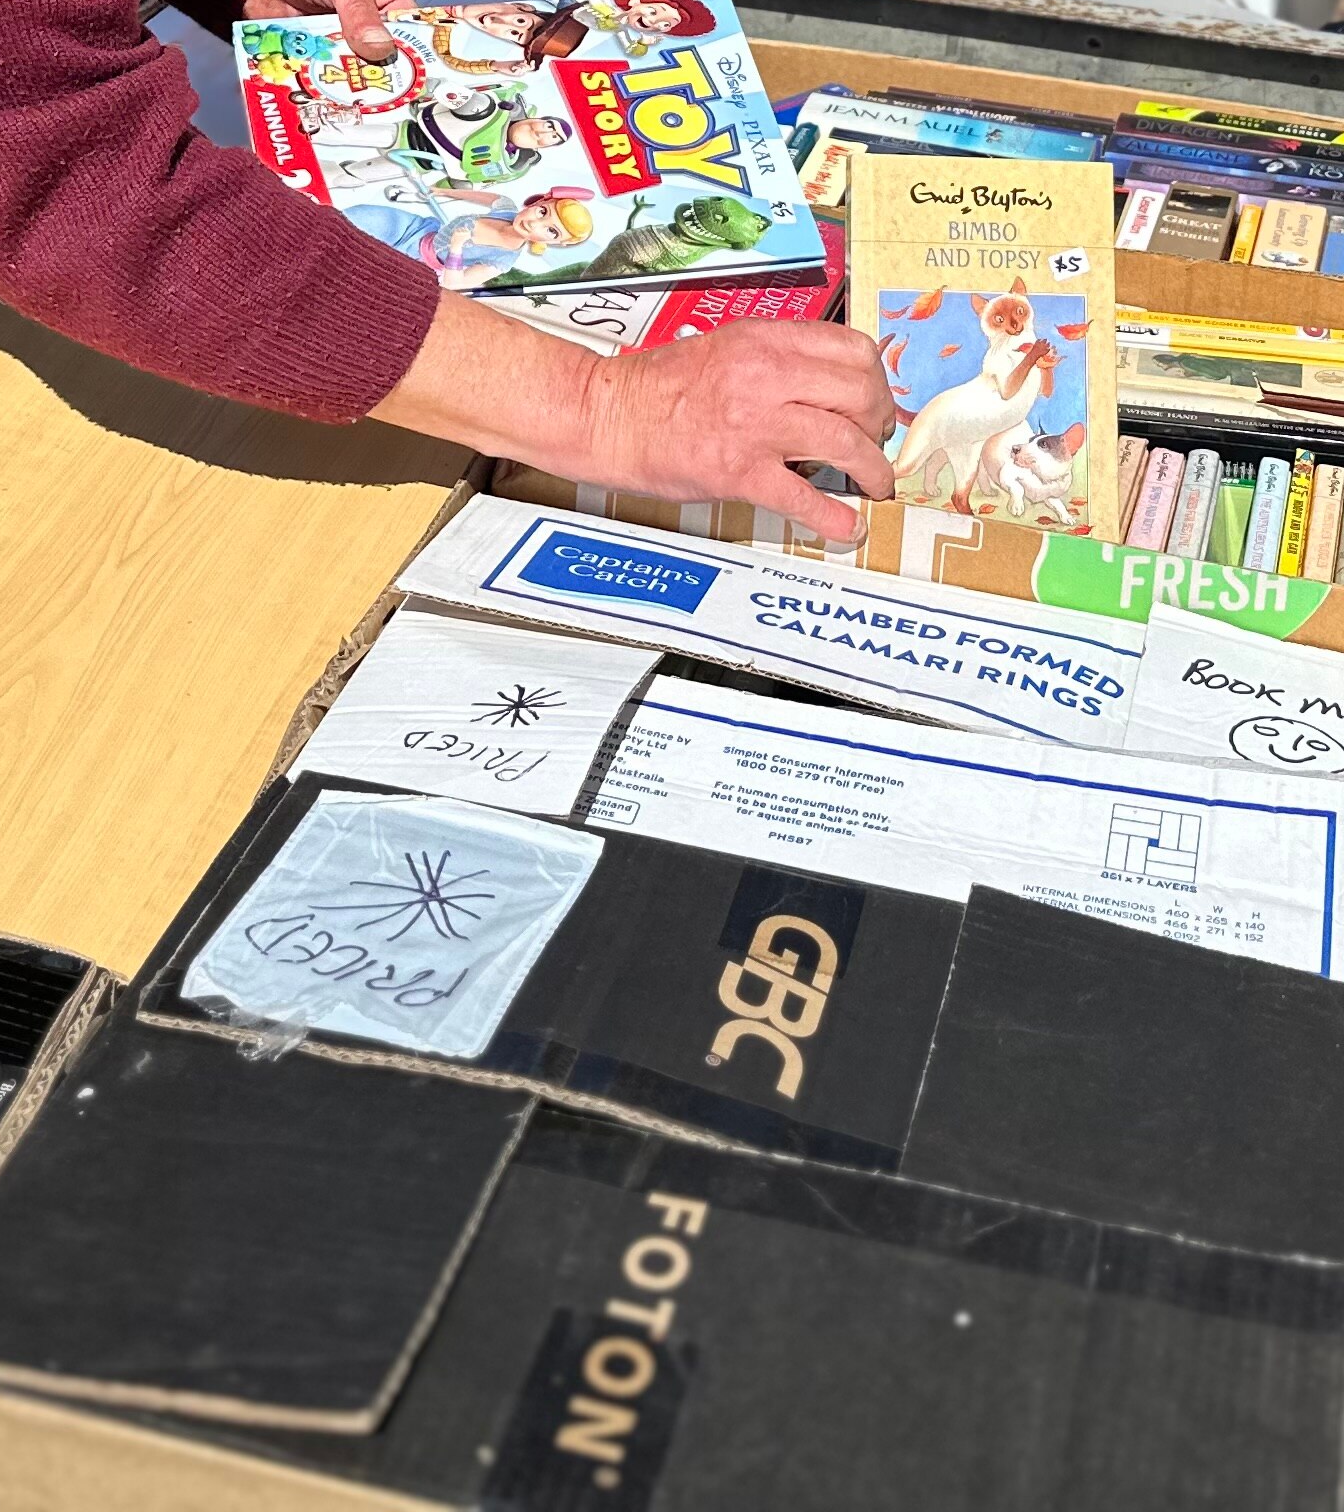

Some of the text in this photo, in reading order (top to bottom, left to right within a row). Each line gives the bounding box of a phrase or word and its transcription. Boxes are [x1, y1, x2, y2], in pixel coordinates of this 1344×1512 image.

[392, 28, 436, 64] FEATURING
[257, 91, 294, 165] ANNUAL
[580, 71, 642, 180] STORY
[612, 45, 752, 196] TOY
[824, 103, 985, 139] JEAN M AUEL
[1135, 119, 1244, 144] DIVERGENT
[742, 120, 776, 175] PIXAR
[1122, 139, 1250, 165] ALLEGIANT
[771, 201, 794, 218] $5
[910, 182, 1053, 213] Enid Blyton's
[948, 221, 1018, 242] BIMBO
[1159, 227, 1219, 243] STORIES
[1162, 214, 1222, 231] GREAT
[924, 248, 1042, 270] AND TOPSY
[1054, 255, 1083, 274] $5
[1126, 407, 1199, 422] WHOSE HAND
[554, 543, 702, 589] Captain's
[567, 562, 669, 594] Catch
[761, 565, 835, 590] FROZEN
[1119, 554, 1288, 613] FRESH
[749, 592, 1127, 701] CRUMBED FORMED
[755, 613, 1104, 718] CALAMARI RINGS
[1181, 658, 1287, 706] BOOK
[623, 745, 652, 759] Park
[633, 725, 674, 742] licence
[676, 736, 692, 747] by
[647, 739, 668, 751] Ltd
[403, 727, 554, 783] PRICED
[723, 745, 905, 789] Simplot Consumer Information
[609, 765, 665, 785] Australia
[735, 758, 885, 796] 1800 061 279 (Toll Free)
[575, 802, 616, 819] origins
[584, 794, 633, 813] Zealand
[711, 790, 890, 834] Not to be used as bait food
[713, 780, 892, 826] For human consumption only.
[736, 805, 856, 838] for aquatic animals.
[1146, 878, 1198, 894] LAYERS
[1022, 884, 1266, 932] INTERNAL DIMENSIONS 460 265 140
[1084, 905, 1264, 943] DIMENSIONS 466 271 152
[243, 911, 469, 1009] PRICED
[718, 913, 838, 1101] GBC
[554, 1190, 709, 1465] FOTON
